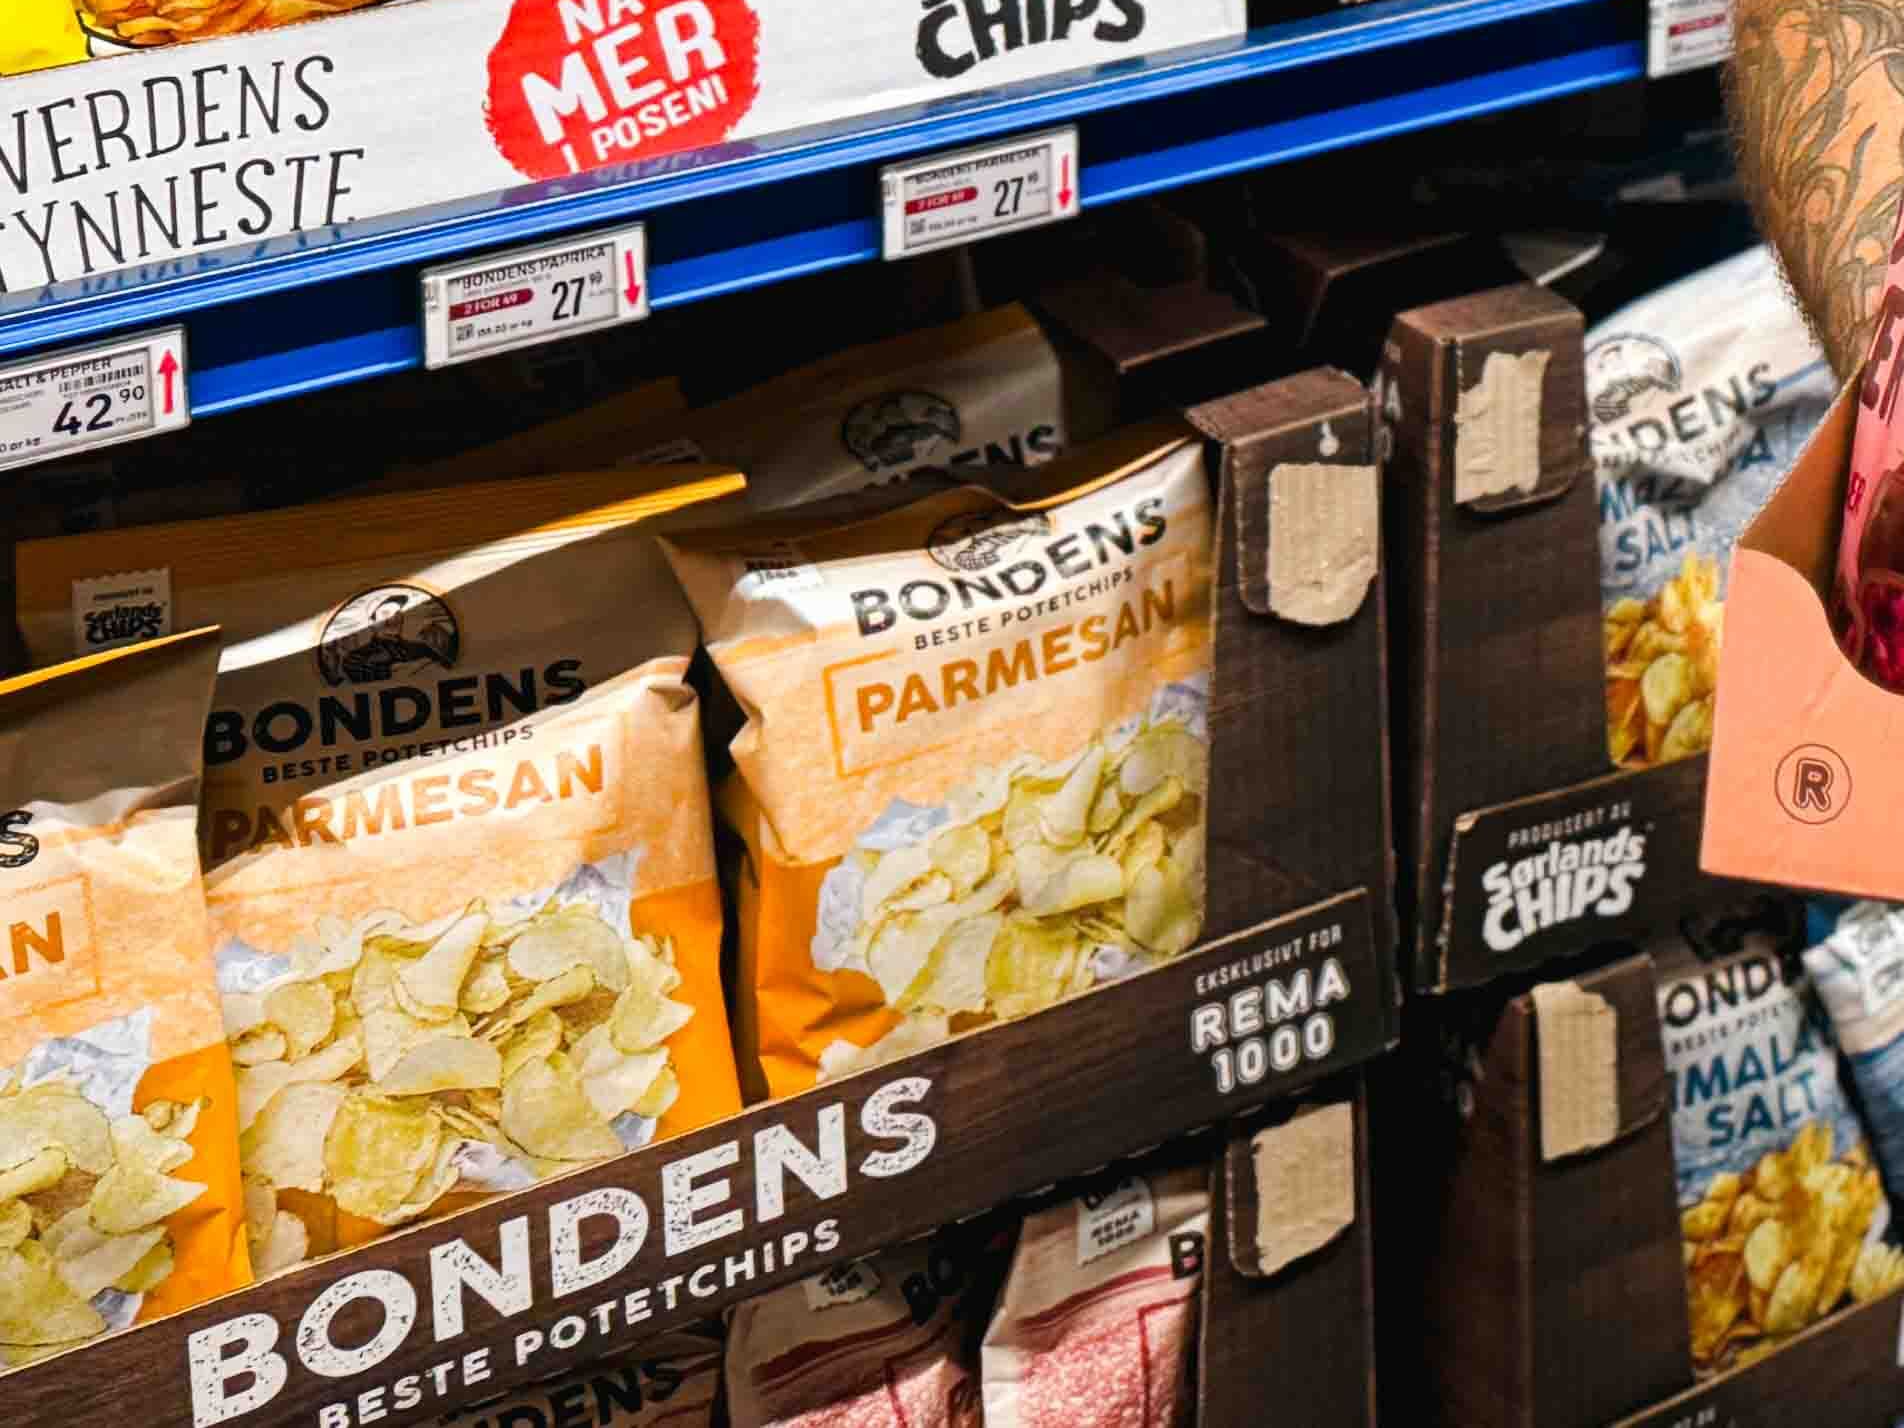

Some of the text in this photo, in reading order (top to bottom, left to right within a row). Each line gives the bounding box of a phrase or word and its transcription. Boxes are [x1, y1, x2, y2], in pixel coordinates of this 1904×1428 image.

[560, 144, 577, 176] I
[993, 175, 1026, 218] 27
[463, 259, 537, 291] BONDENS
[551, 276, 587, 322] 27
[50, 356, 114, 382] PEPPER
[52, 385, 146, 436] 42 90
[849, 495, 1169, 638] BONDENS
[913, 566, 1135, 652] BESTE POTETCHIPS
[854, 580, 1178, 733] PARMESAN
[202, 658, 588, 767] BONDENS
[261, 723, 536, 785] BESTE POTETCHIPS
[1793, 759, 1833, 809] R
[206, 743, 608, 861] PARMESAN
[1481, 825, 1648, 906] Sørlands
[1481, 862, 1648, 953] CHIPS
[1194, 924, 1343, 998] EKSKLUSIVT FOR
[1190, 956, 1351, 1055] REMA
[1211, 1012, 1335, 1094] 1000
[1705, 1070, 1820, 1148] SALT
[184, 1075, 938, 1428] BONDENS
[318, 1218, 842, 1428] BESTE POTETCHIPS
